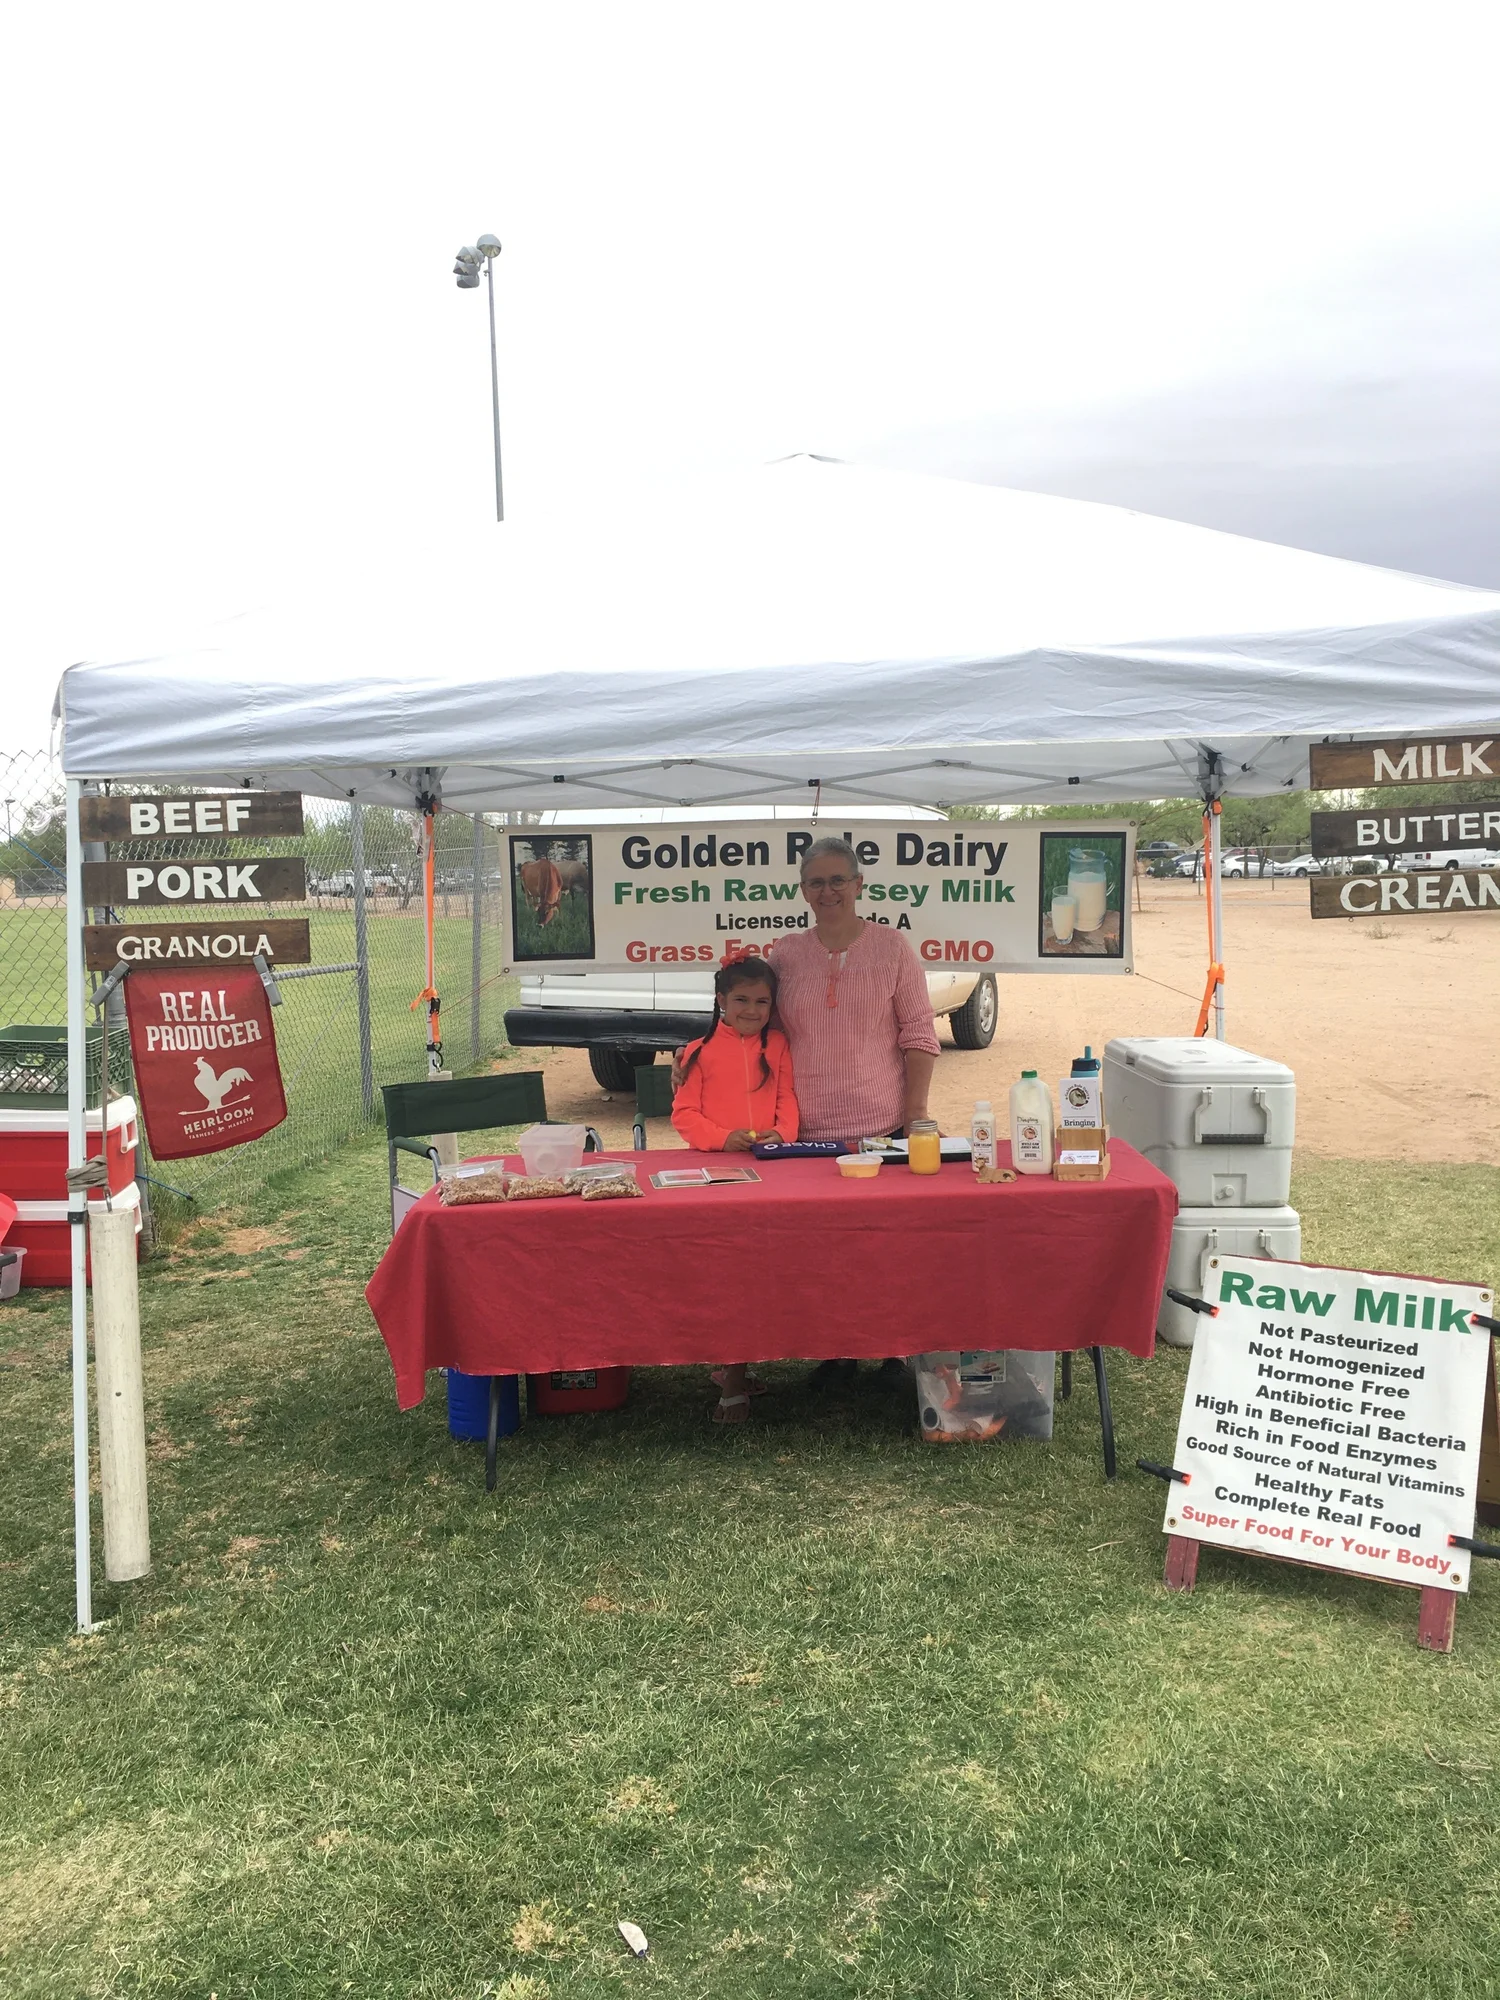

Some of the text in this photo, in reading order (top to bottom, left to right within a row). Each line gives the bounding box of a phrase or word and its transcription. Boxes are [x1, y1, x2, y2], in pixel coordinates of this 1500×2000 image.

[1373, 741, 1494, 782] MILK
[130, 800, 251, 835] BEEF
[1356, 811, 1500, 847] BUTTER
[622, 834, 770, 869] Golden
[897, 832, 1008, 876] Dairy
[127, 865, 262, 900] PORK
[614, 881, 711, 905] Fresh
[724, 879, 800, 902] Raw
[942, 879, 1015, 903] Milk
[716, 911, 809, 931] Licensed
[896, 913, 911, 930] A
[116, 934, 274, 960] GRANOLA
[626, 941, 714, 963] Grass
[920, 940, 994, 962] GMO
[159, 990, 235, 1022] REAL
[146, 1019, 262, 1052] PRODUCER
[183, 1107, 254, 1135] HEIRLOOM
[1064, 1119, 1096, 1127] Bringing
[1219, 1271, 1471, 1335] Raw Milk
[1259, 1321, 1419, 1357] Not Pasteurized
[1248, 1341, 1425, 1380] Not Homogenized
[1257, 1363, 1410, 1399] Hormone Free
[1255, 1384, 1406, 1421] Antibiotic Free
[1195, 1394, 1466, 1452] High in Beneficial Bacteria
[1215, 1419, 1437, 1471] Rich in Food Enzymes
[1186, 1436, 1465, 1497] Good Source of Natural Vitamins
[1254, 1472, 1384, 1509] Healthy Fats
[1215, 1485, 1421, 1538] Complete Real Food
[1183, 1505, 1451, 1575] Super Food For Your Body
